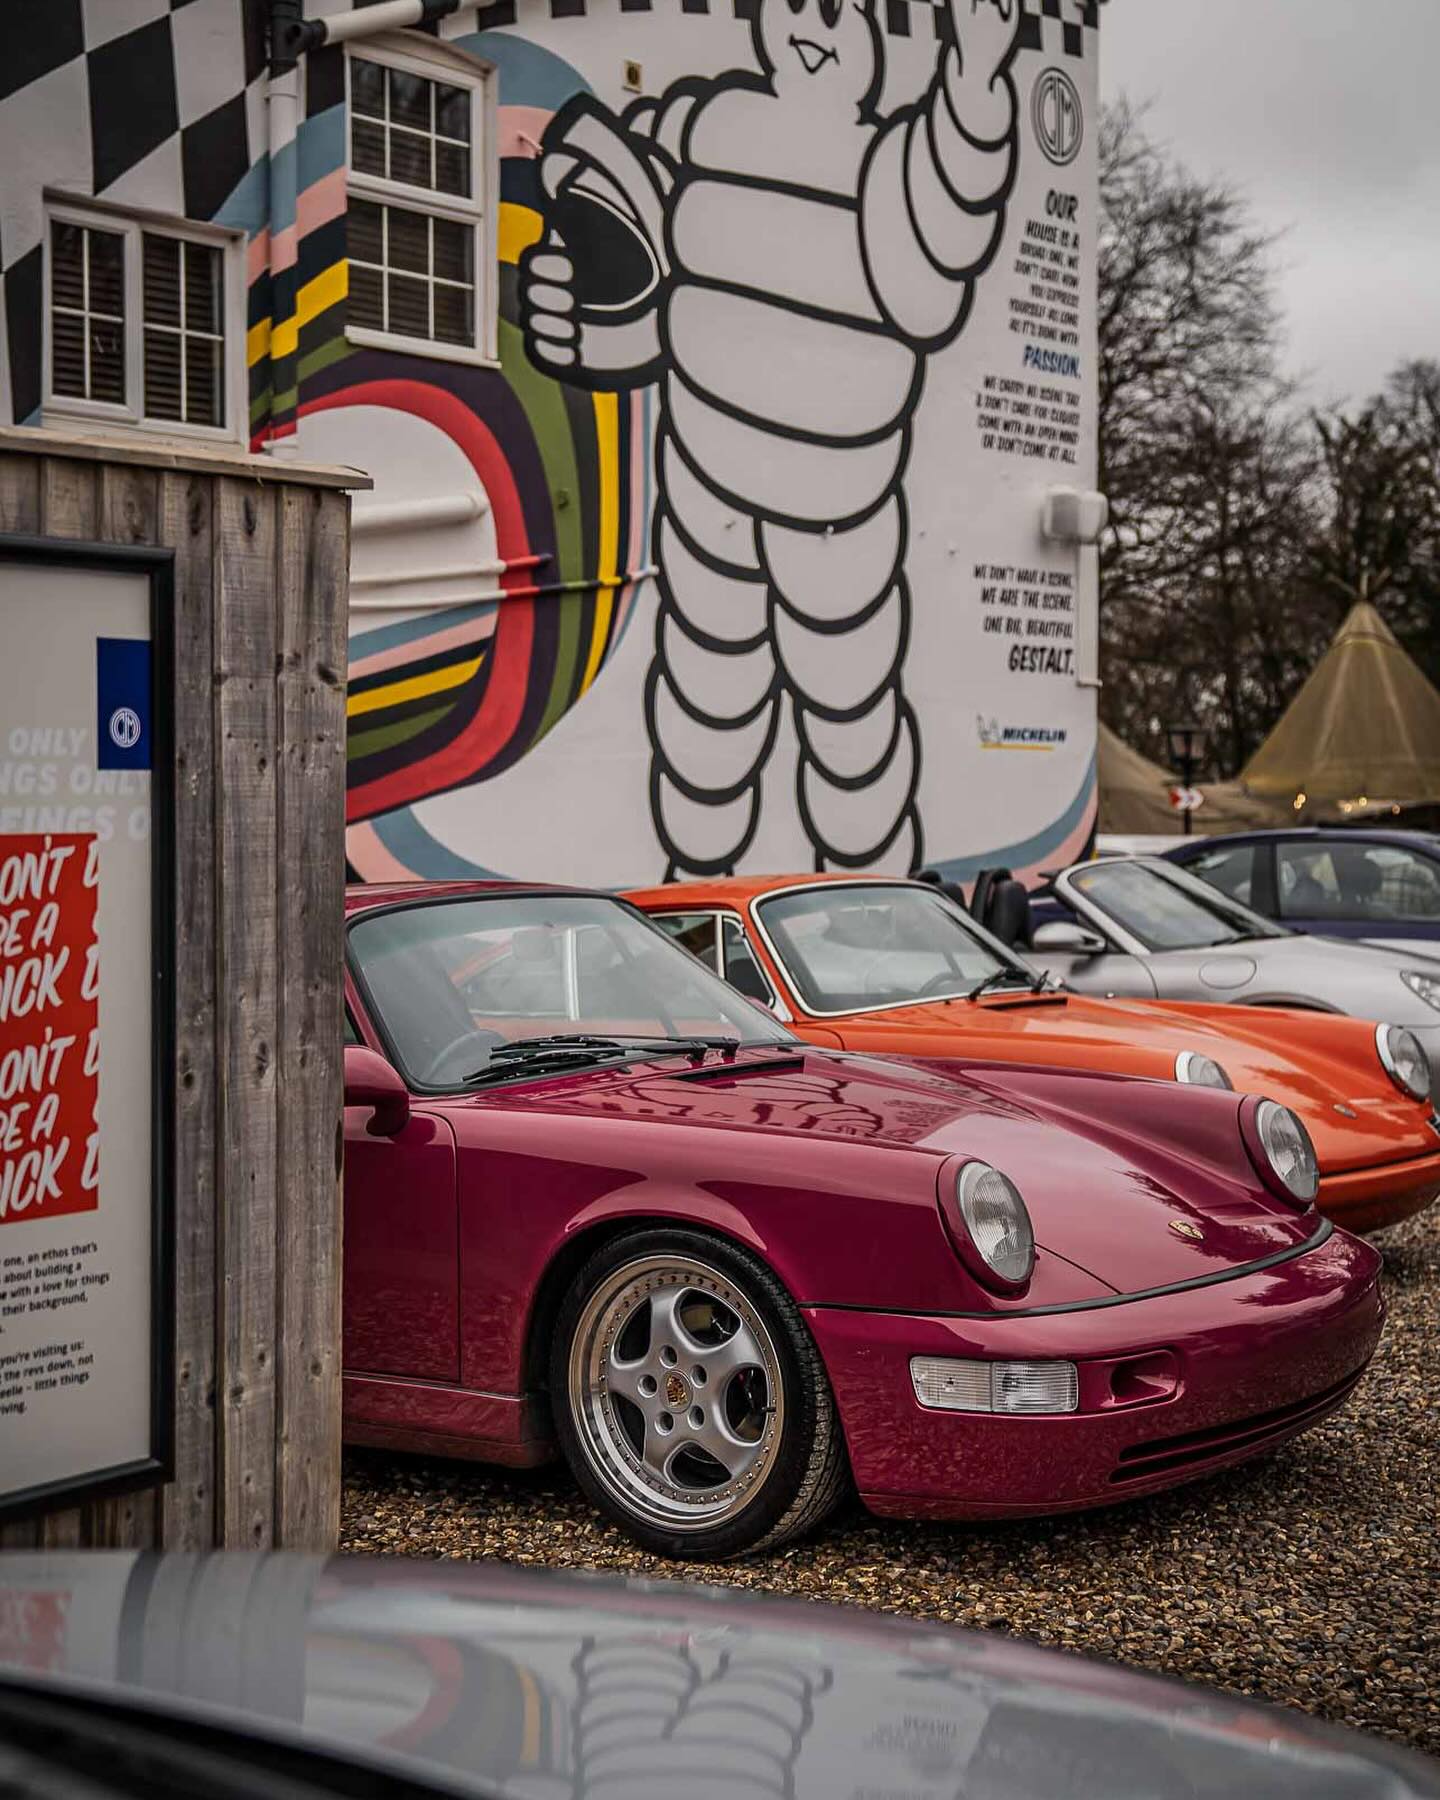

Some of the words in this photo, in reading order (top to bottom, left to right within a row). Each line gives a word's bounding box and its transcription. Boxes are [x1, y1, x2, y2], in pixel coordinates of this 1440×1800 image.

[1046, 190, 1079, 223] OUR
[1026, 220, 1058, 244] HOUSE
[1060, 230, 1070, 248] IS
[1072, 233, 1079, 249] A
[1014, 259, 1039, 277] DON'T
[1040, 267, 1060, 282] CARE
[1031, 284, 1044, 298] YOU
[1046, 287, 1079, 308] EXPRESS
[1009, 298, 1047, 318] YOURSELF
[1060, 311, 1078, 328] LONG
[1022, 320, 1036, 337] IT'S
[1038, 325, 1058, 341] DONE
[1060, 331, 1078, 345] WITH
[1023, 345, 1081, 379] PASSION.
[984, 376, 996, 389] WE
[1040, 387, 1063, 403] SCENE
[985, 395, 1009, 412] DON'T
[1012, 401, 1031, 416] CARE
[1034, 405, 1048, 419] FOR
[978, 414, 1000, 430] COME
[1003, 420, 1021, 433] WITH
[1025, 423, 1035, 435] AN
[1039, 426, 1057, 441] OPEN
[983, 434, 994, 449] OR
[997, 435, 1022, 454] DON'T
[1023, 440, 1047, 459] COME
[1049, 445, 1059, 460] AT
[974, 564, 986, 579] WE
[990, 565, 1016, 580] DON'T
[1018, 569, 1039, 584] HAVE
[1041, 570, 1046, 585] A
[982, 587, 997, 605] WE
[1000, 588, 1019, 606] ARE
[1022, 590, 1039, 609] THE
[1042, 592, 1073, 611] SCENE.
[984, 616, 1003, 633] ONE
[1027, 619, 1074, 639] BEAUTIFUL
[1008, 644, 1075, 676] GESTALT.
[8, 727, 87, 757] ONLY
[1003, 728, 1067, 743] MICHELIN
[0, 761, 58, 796] NGS
[0, 835, 76, 906] ON'T
[31, 902, 60, 950] A
[0, 945, 70, 1023] ICK
[0, 1026, 77, 1101] ON'T
[31, 1093, 60, 1143] A
[0, 1135, 70, 1219] ICK
[28, 1253, 40, 1264] an
[42, 1248, 69, 1261] ethos
[71, 1242, 98, 1256] that's
[4, 1269, 32, 1284] about
[35, 1263, 74, 1279] building
[76, 1262, 82, 1271] a
[11, 1286, 32, 1298] with
[34, 1286, 40, 1294] a
[42, 1282, 62, 1293] love
[65, 1278, 78, 1289] for
[81, 1272, 110, 1286] things
[2, 1303, 26, 1317] their
[33, 1343, 68, 1359] visiting
[4, 1370, 20, 1381] the
[23, 1365, 44, 1377] revs
[78, 1353, 94, 1366] not
[0, 1386, 23, 1399] eelie
[34, 1378, 58, 1392] little
[60, 1371, 90, 1385] things
